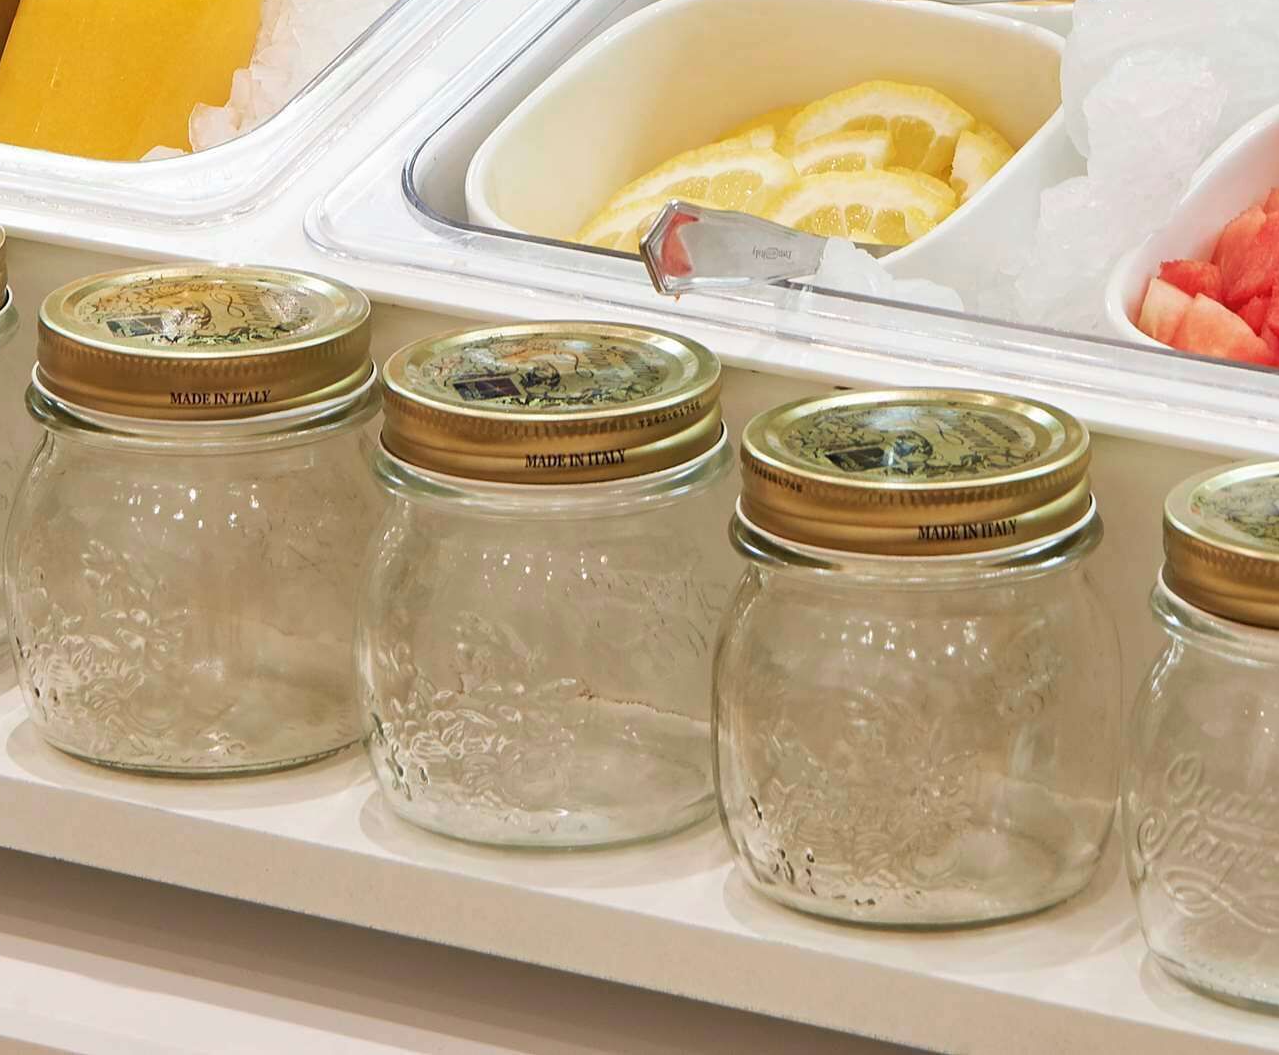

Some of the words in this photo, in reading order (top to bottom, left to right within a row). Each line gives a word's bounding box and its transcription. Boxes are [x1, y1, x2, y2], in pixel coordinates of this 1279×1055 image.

[169, 391, 211, 406] MADE
[214, 392, 229, 406] IN
[231, 388, 272, 405] ITALY
[524, 453, 567, 468] MADE
[568, 452, 585, 467] IN
[587, 448, 625, 466] ITALY
[918, 524, 960, 540] MADE
[962, 523, 979, 540] IN
[981, 518, 1018, 539] ITALY
